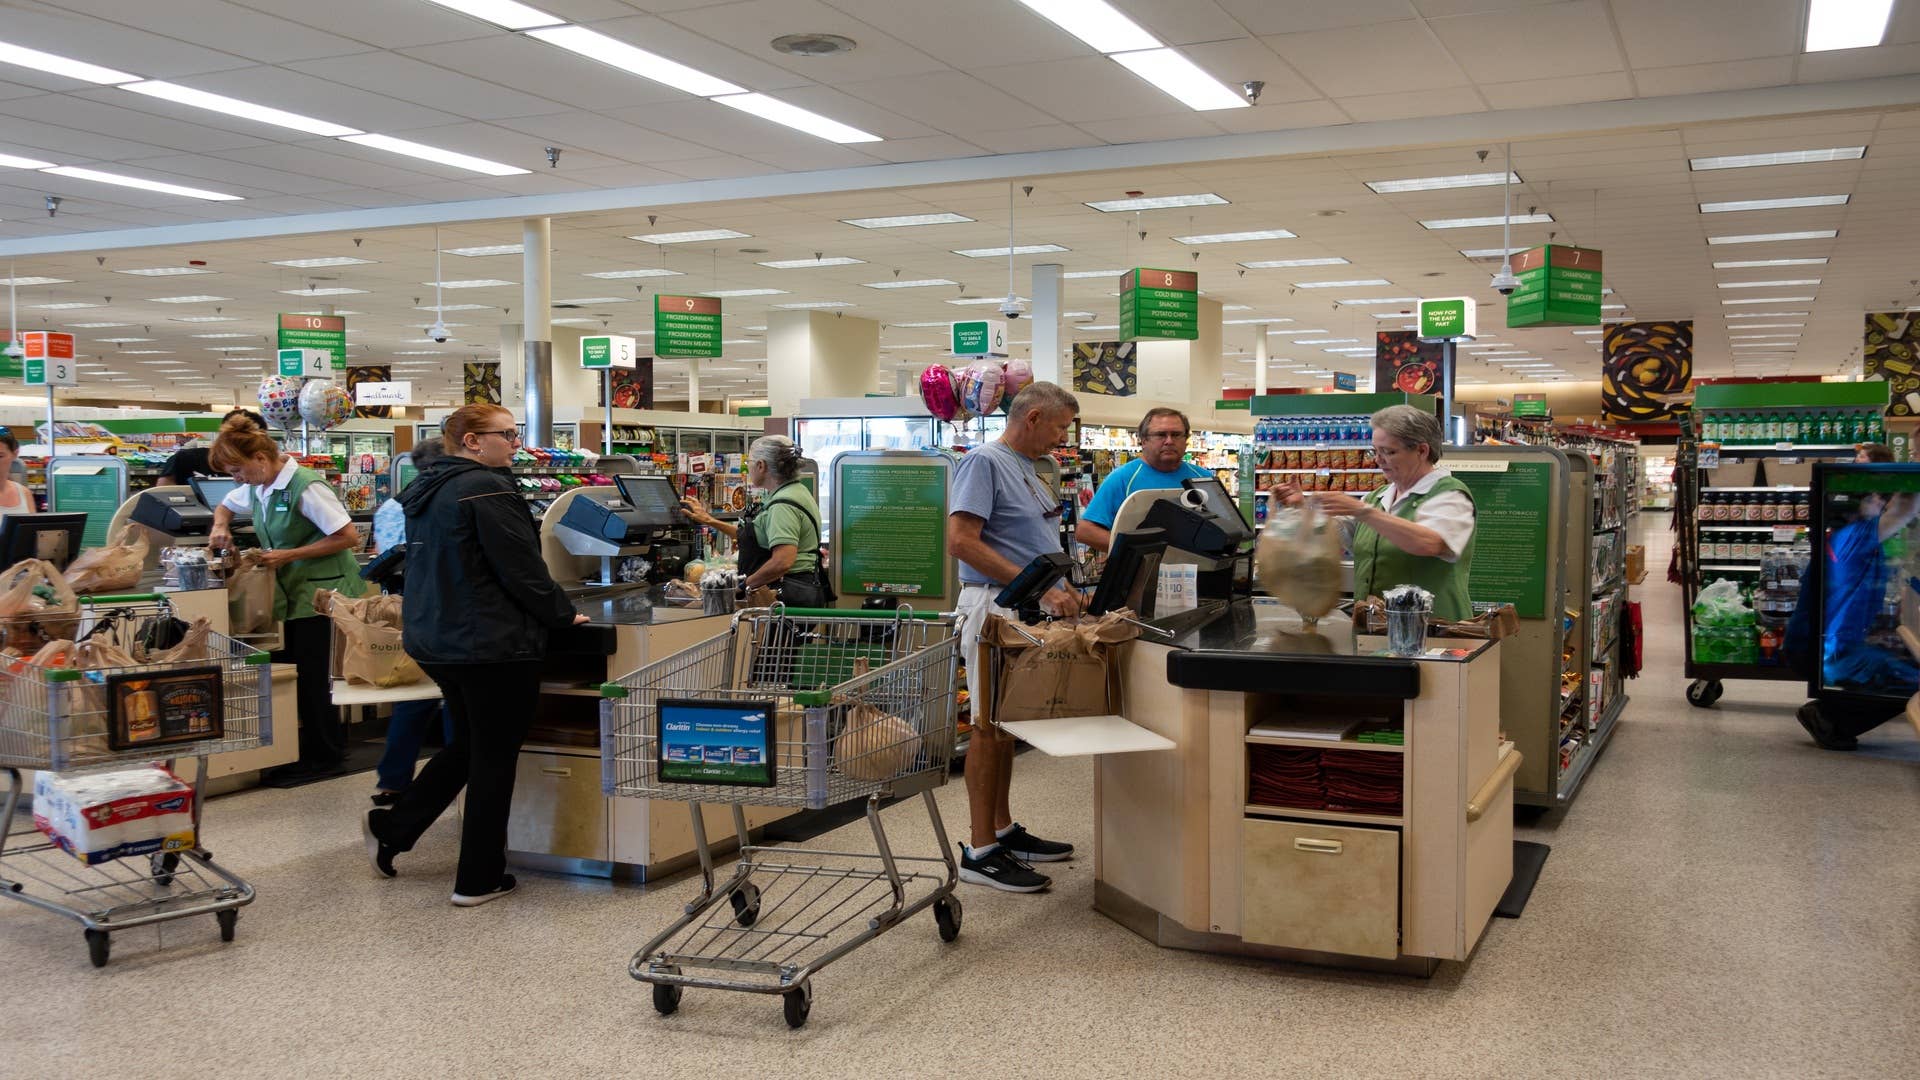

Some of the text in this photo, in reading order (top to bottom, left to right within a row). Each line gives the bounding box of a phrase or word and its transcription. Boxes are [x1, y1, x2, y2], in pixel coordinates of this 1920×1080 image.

[1522, 254, 1529, 268] 7
[1573, 252, 1580, 264] 7
[1165, 273, 1172, 286] 8
[686, 300, 694, 311] 9
[305, 318, 321, 328] 10
[996, 330, 1002, 347] 6
[621, 345, 628, 360] 5
[314, 357, 322, 371] 4
[56, 365, 66, 379] 3
[370, 643, 400, 651] Publi
[666, 723, 690, 731] Claritin
